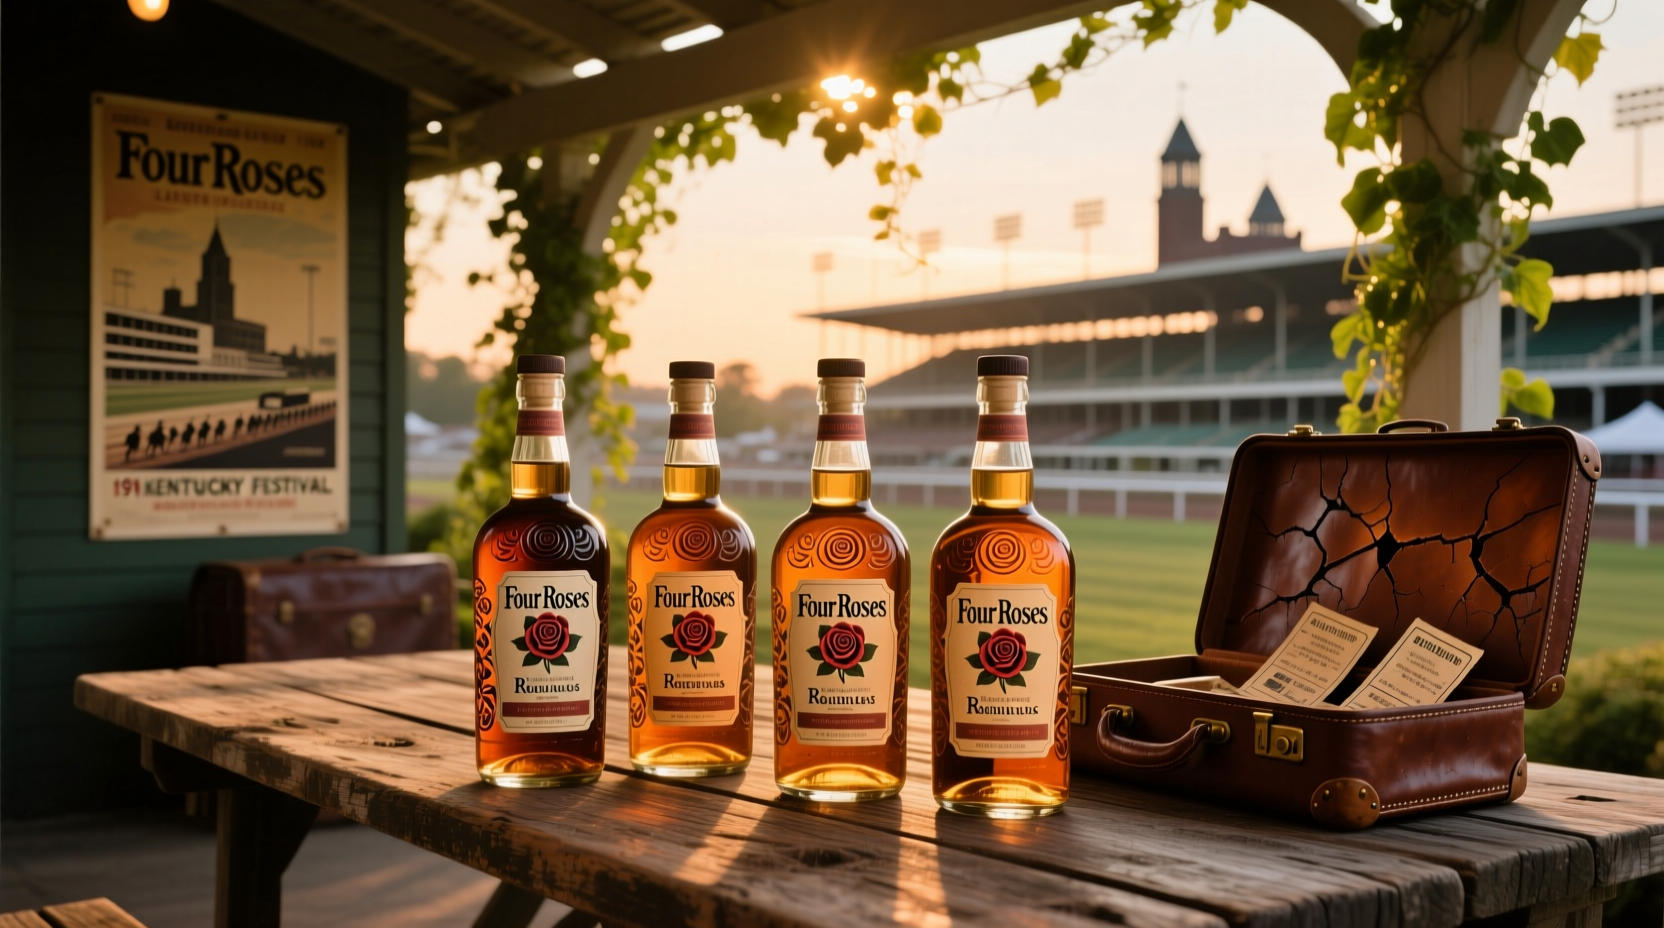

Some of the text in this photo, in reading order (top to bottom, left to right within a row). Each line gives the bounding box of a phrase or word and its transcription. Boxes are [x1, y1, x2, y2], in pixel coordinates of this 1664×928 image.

[144, 477, 245, 497] KENTUCKY
[252, 476, 332, 495] FESTIVAL
[504, 585, 590, 609] Four Roses
[654, 585, 735, 608] Four Roses
[797, 593, 886, 618] Four Roses
[956, 598, 1048, 625] Four Roses
